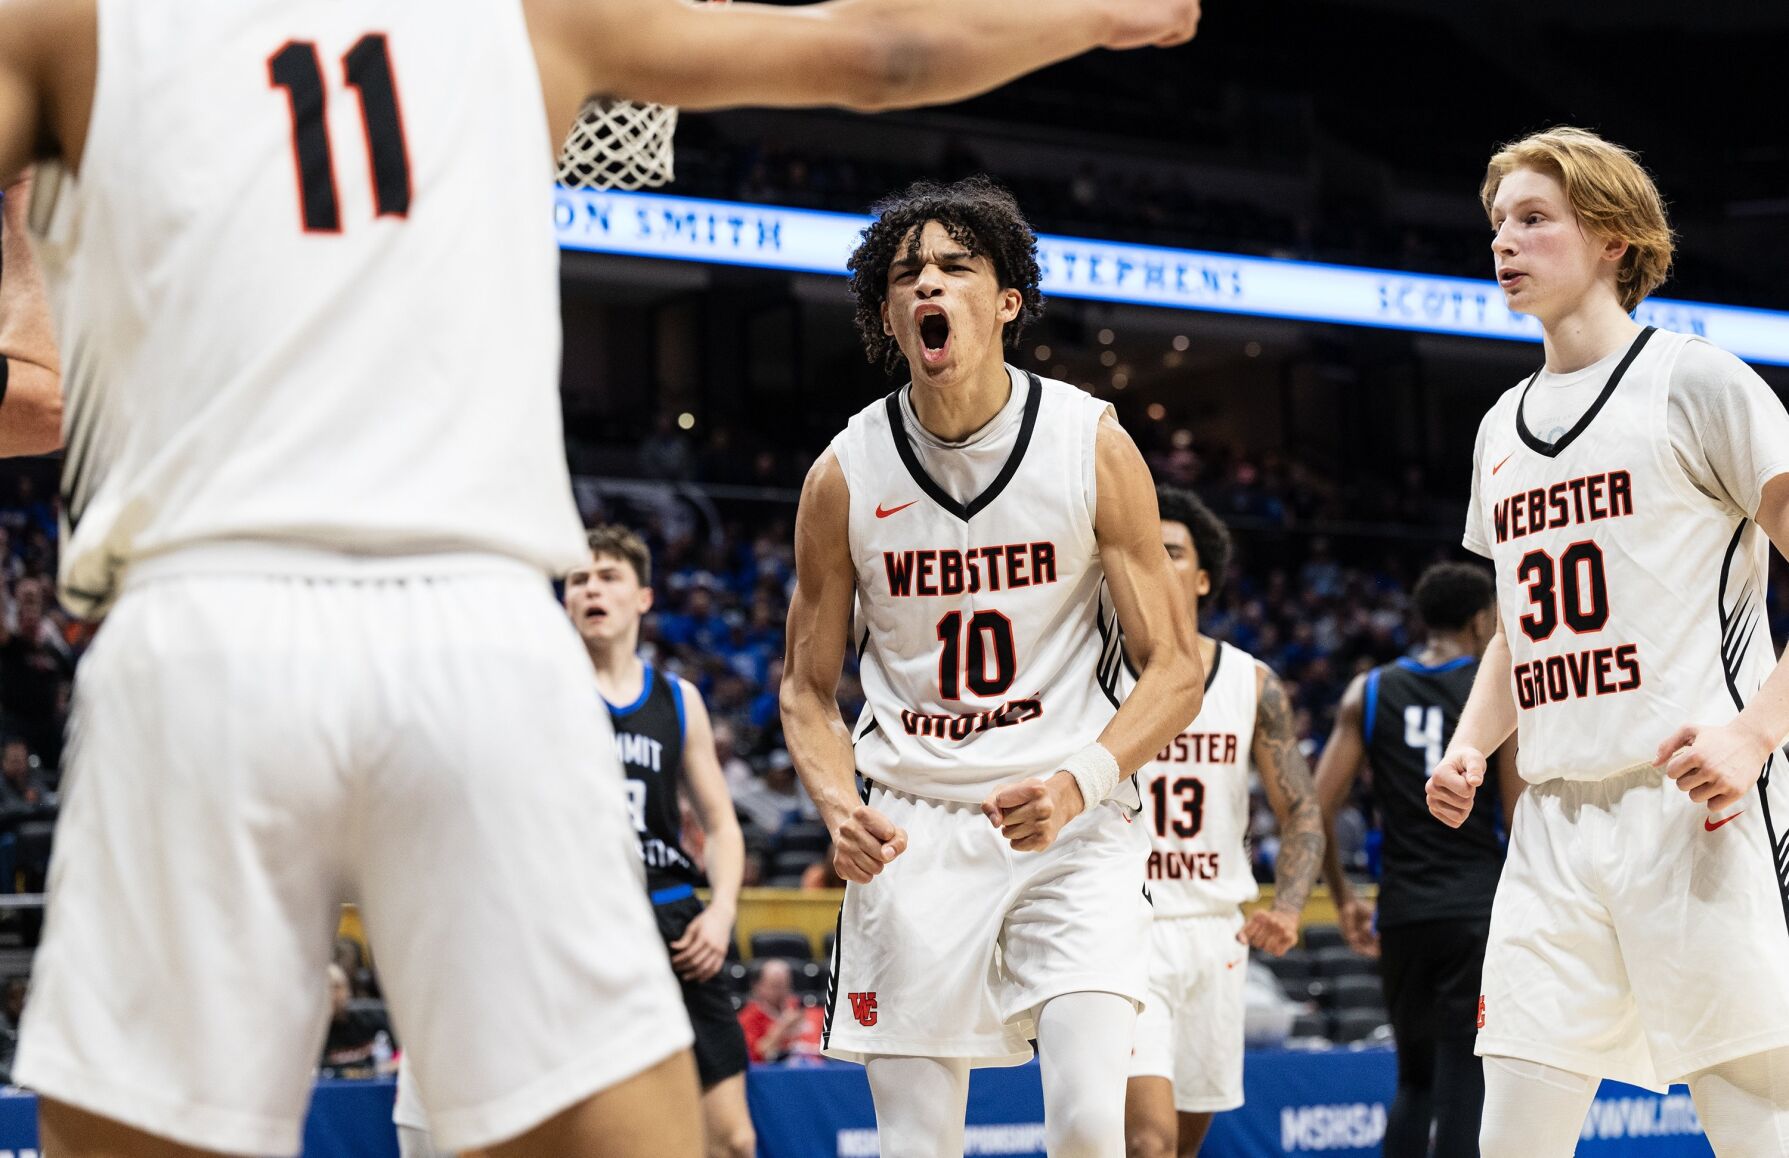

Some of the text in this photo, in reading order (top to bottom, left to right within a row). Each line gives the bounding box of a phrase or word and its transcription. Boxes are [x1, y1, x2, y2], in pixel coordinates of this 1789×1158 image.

[266, 31, 415, 235] 11
[636, 206, 784, 250] SMITH
[1378, 284, 1488, 324] SCOTT
[1493, 469, 1634, 544] WEBSTER
[883, 541, 1057, 597] WEBSTER
[1516, 539, 1610, 644] 30
[936, 608, 1017, 701] 10
[1513, 643, 1641, 710] GROVES
[1403, 705, 1443, 777] 4
[1149, 774, 1205, 840] 13
[847, 992, 878, 1027] WG
